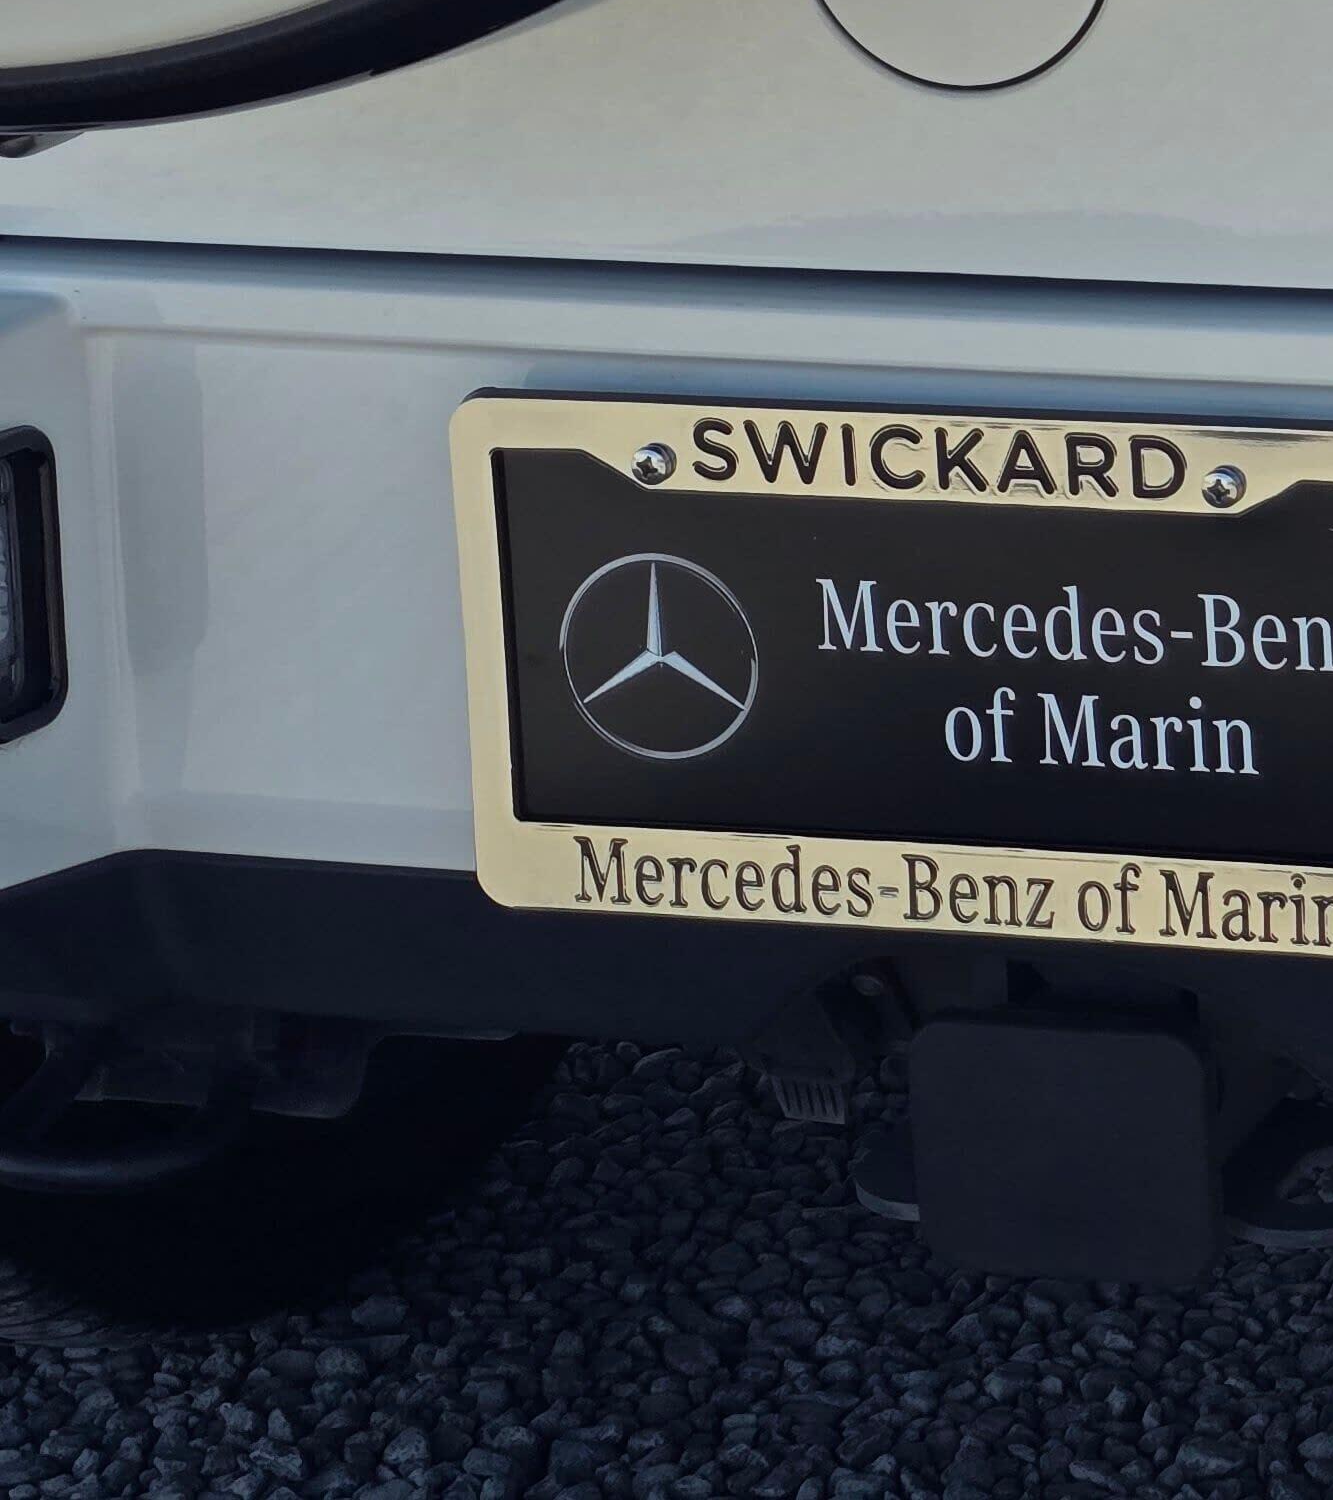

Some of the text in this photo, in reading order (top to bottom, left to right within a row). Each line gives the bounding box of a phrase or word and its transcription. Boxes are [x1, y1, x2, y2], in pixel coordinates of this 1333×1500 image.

[692, 416, 1188, 501] SWICKARD
[944, 686, 1260, 777] of Marin
[573, 834, 1056, 932] Mercedes-Benz
[1076, 866, 1138, 936] of
